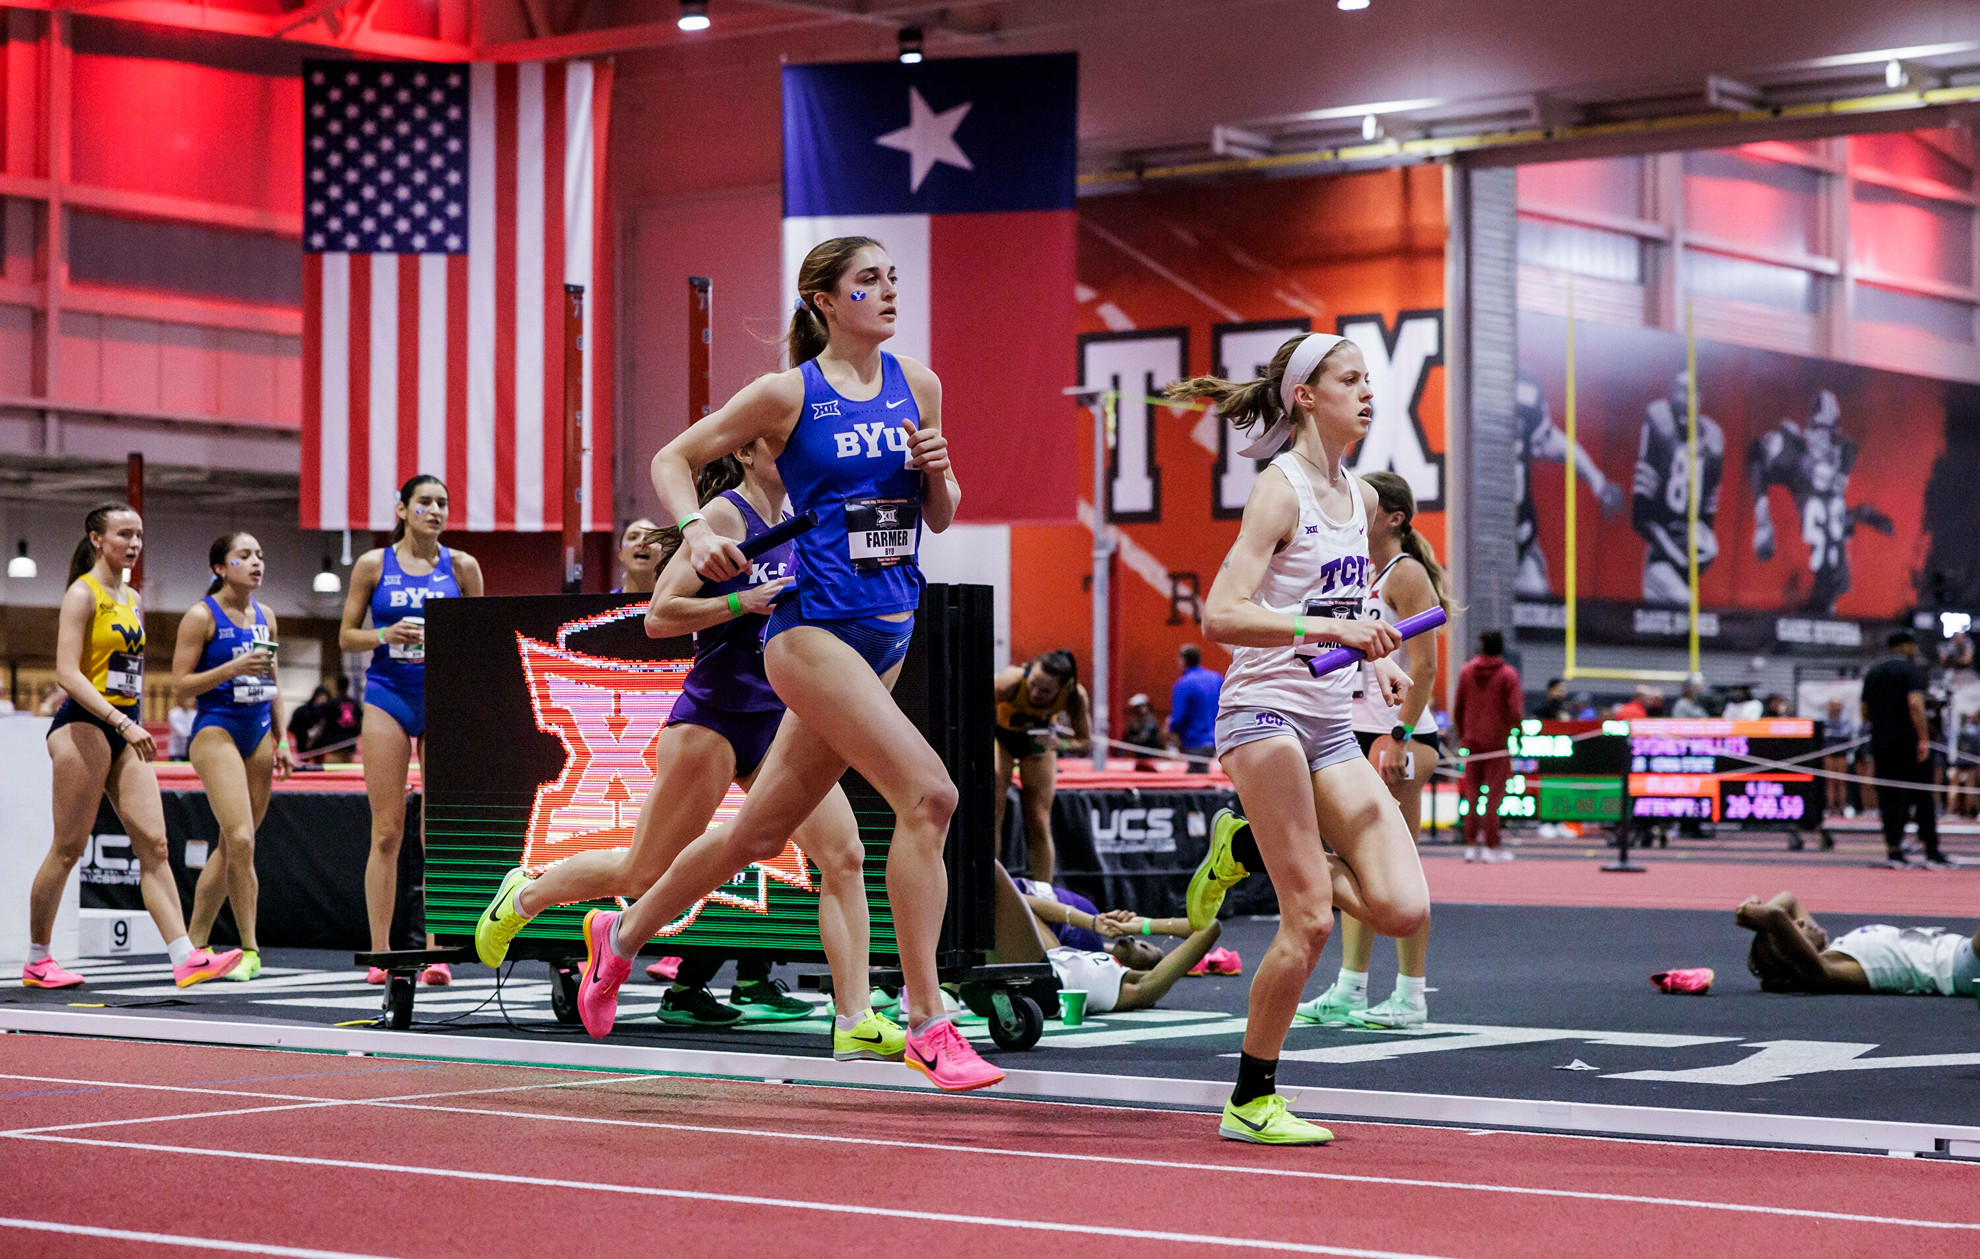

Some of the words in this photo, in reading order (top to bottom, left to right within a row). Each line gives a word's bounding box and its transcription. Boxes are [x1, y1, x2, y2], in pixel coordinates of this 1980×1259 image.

[834, 421, 909, 458] BYU
[865, 530, 909, 548] FARMER
[1255, 713, 1284, 727] TCU
[1091, 808, 1175, 840] UCS
[114, 921, 128, 947] 9
